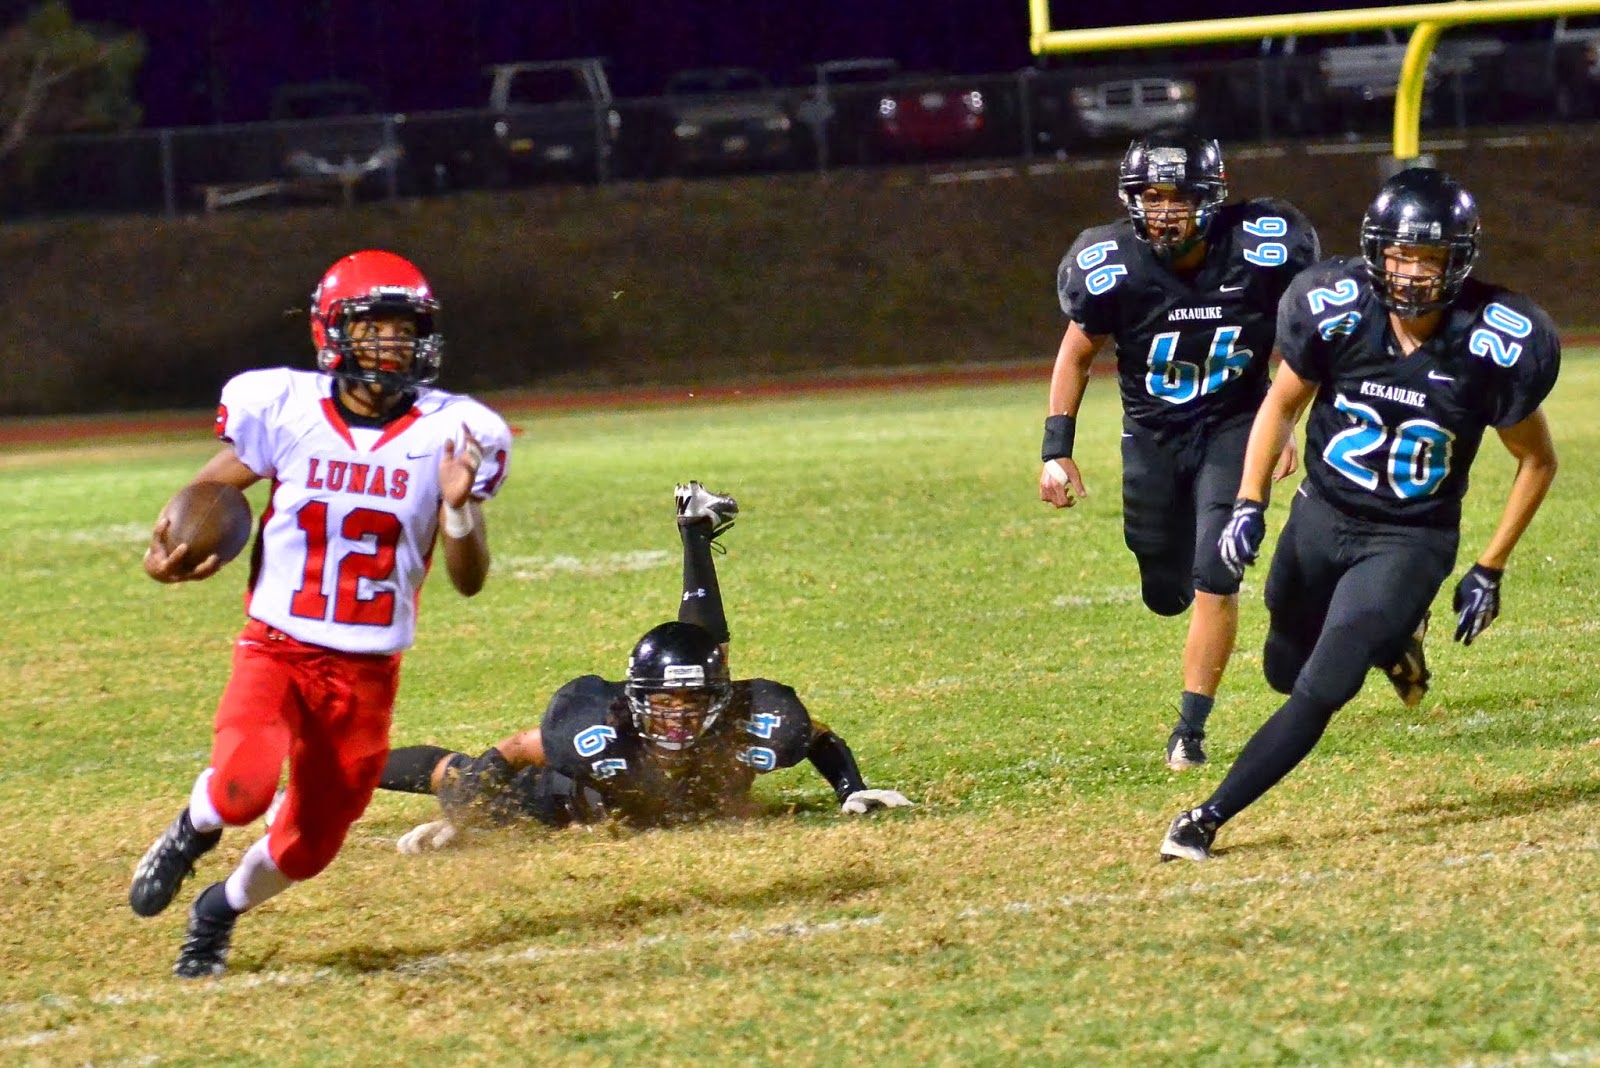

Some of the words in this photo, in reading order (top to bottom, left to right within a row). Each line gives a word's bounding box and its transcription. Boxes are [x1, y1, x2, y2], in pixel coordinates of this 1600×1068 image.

[1076, 240, 1128, 295] 66
[1243, 217, 1288, 267] 66
[1168, 306, 1223, 321] KEKAULIKE
[1469, 303, 1532, 368] 20
[1361, 382, 1426, 408] KEKAULIKE
[1323, 393, 1456, 499] 20
[306, 458, 409, 500] LUNAS
[290, 500, 402, 626] 12
